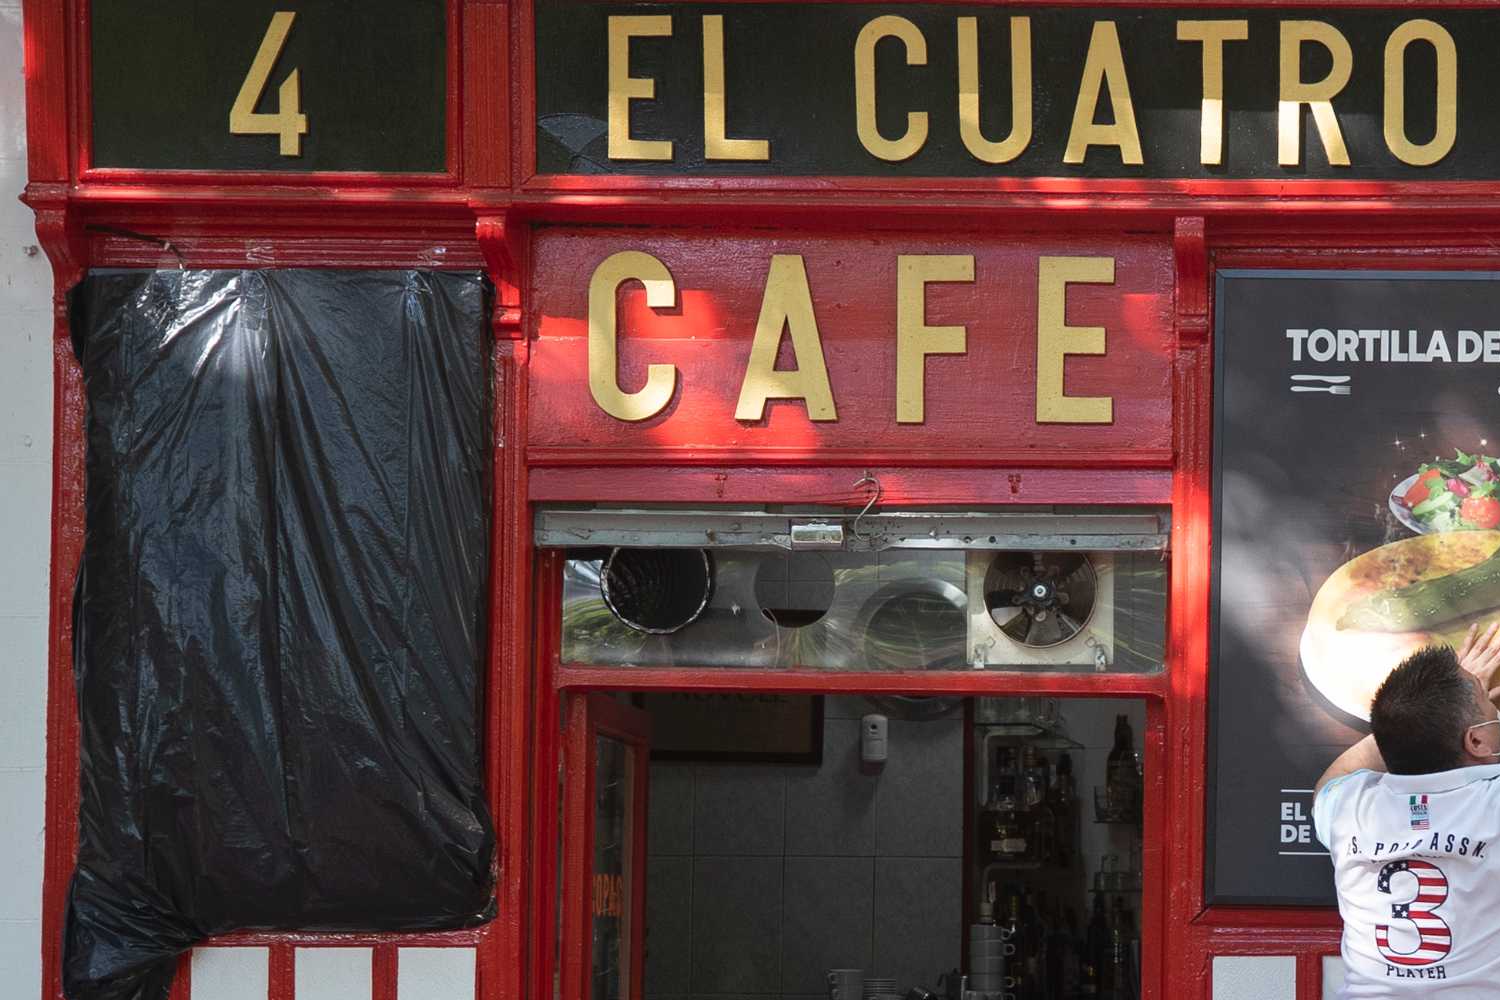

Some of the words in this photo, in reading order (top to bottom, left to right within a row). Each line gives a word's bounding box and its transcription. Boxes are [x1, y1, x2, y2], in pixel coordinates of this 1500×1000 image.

[229, 11, 307, 156] 4
[607, 14, 770, 161] EL
[854, 14, 1458, 167] CUATRO
[587, 250, 1115, 424] CAFE
[1286, 328, 1453, 363] TORTILLA
[1280, 802, 1307, 821] EL
[1280, 824, 1311, 844] DE
[1374, 859, 1453, 966] 3
[1386, 963, 1447, 980] PLAYER
